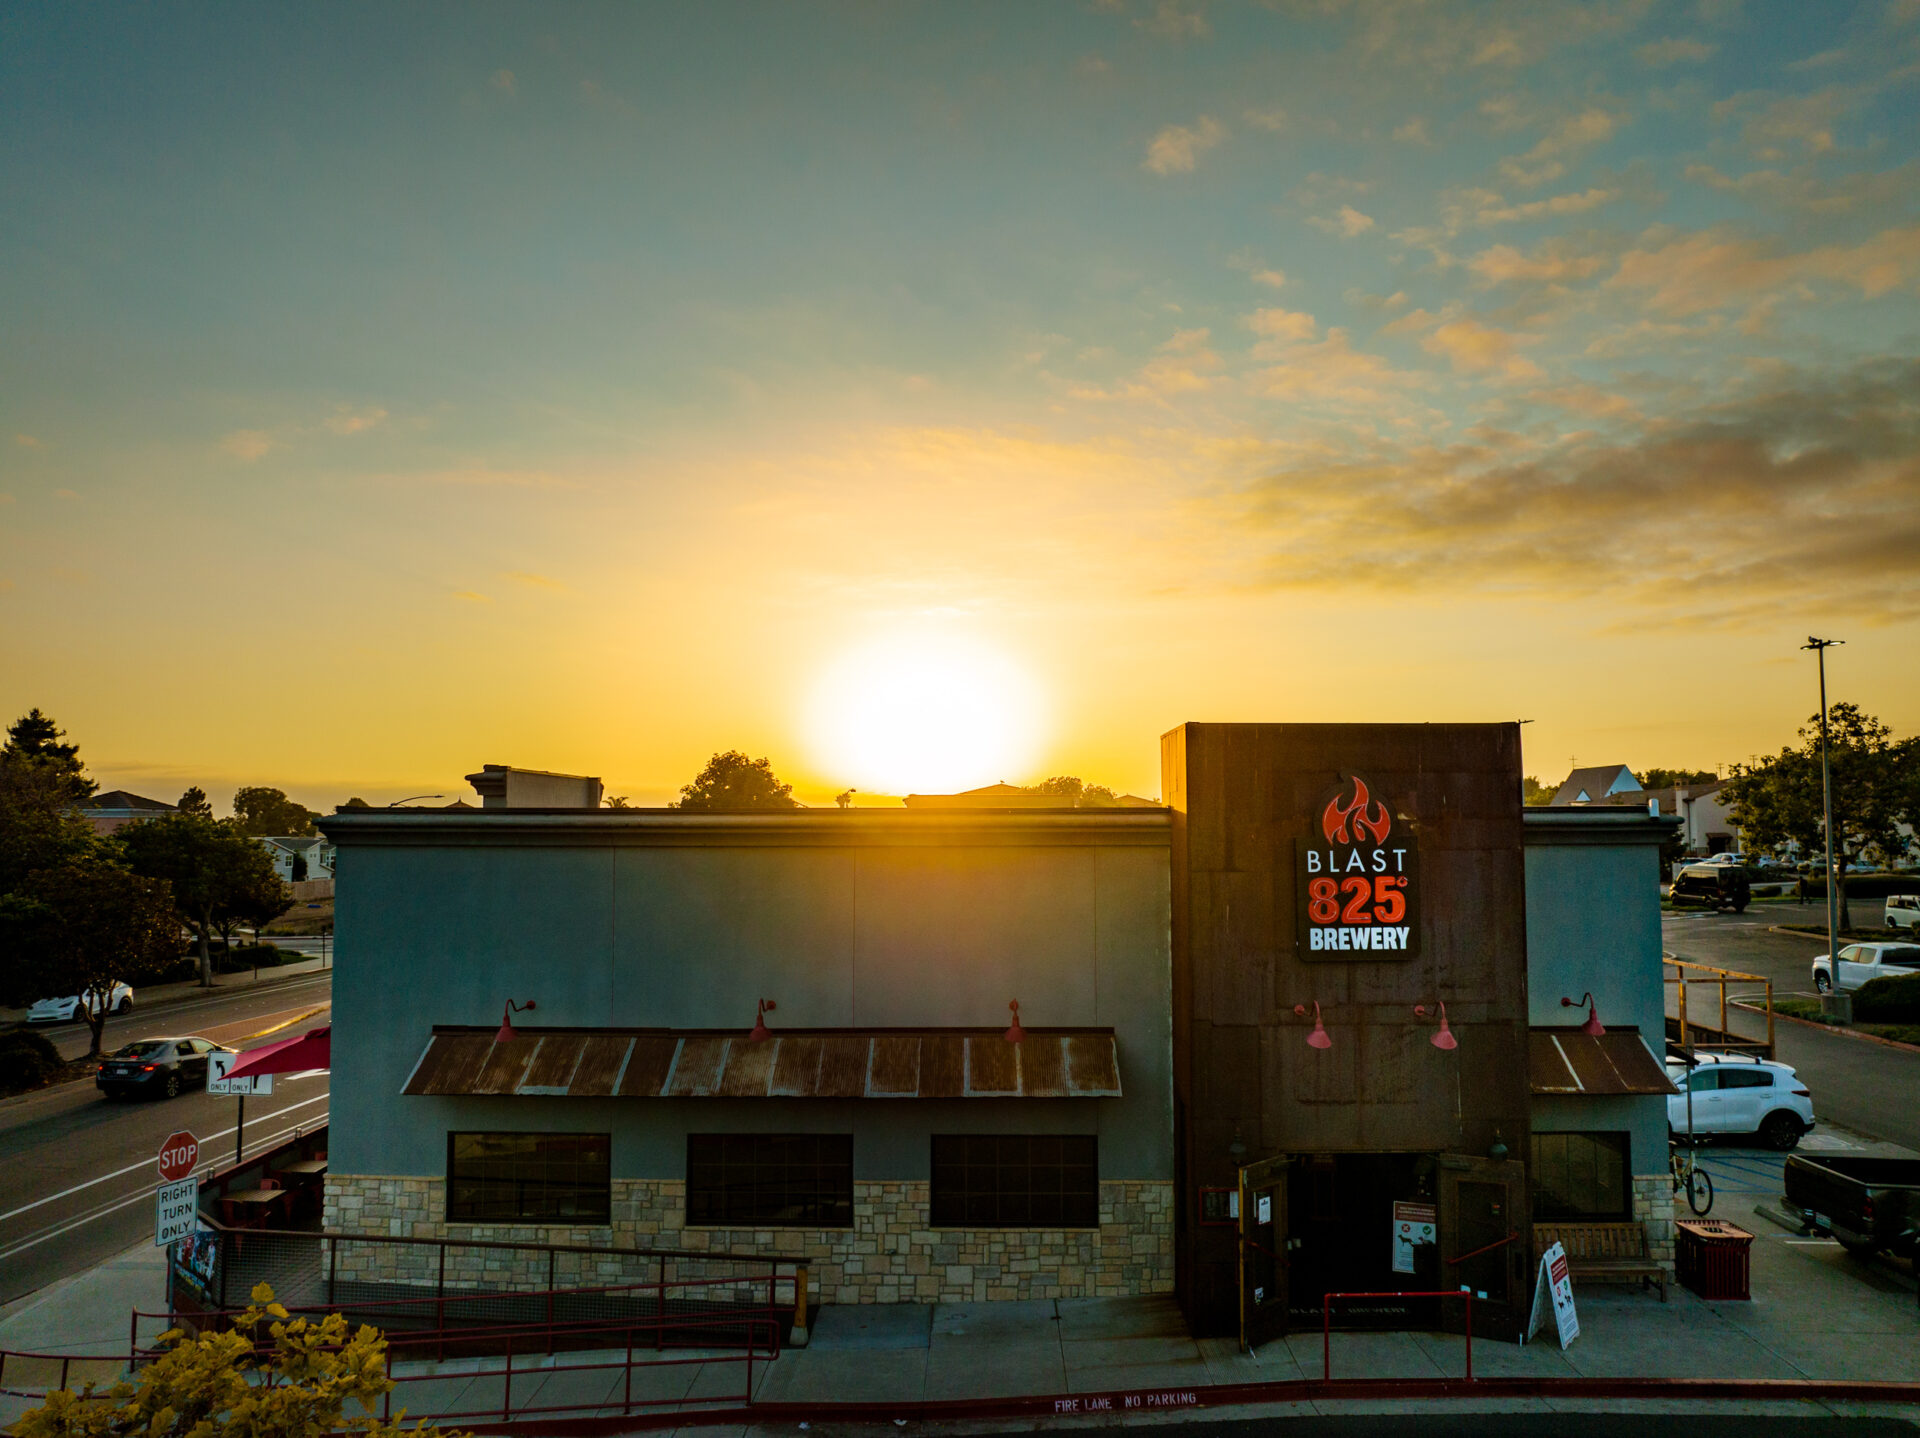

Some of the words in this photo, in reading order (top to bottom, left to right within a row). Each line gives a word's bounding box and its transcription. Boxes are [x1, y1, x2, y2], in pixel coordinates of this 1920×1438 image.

[1307, 848, 1407, 873] BLAST
[1310, 927, 1410, 951] BREWERY
[210, 1083, 227, 1091] ONLY
[232, 1084, 248, 1092] ONLY
[161, 1144, 196, 1169] STOP
[161, 1183, 194, 1203] RIGHT
[163, 1202, 192, 1221] TURN
[161, 1220, 191, 1240] ONLY
[1054, 1400, 1080, 1413] FIRE
[1084, 1398, 1113, 1411] LANE
[1125, 1395, 1141, 1408] NO
[1147, 1392, 1197, 1406] PARKING
